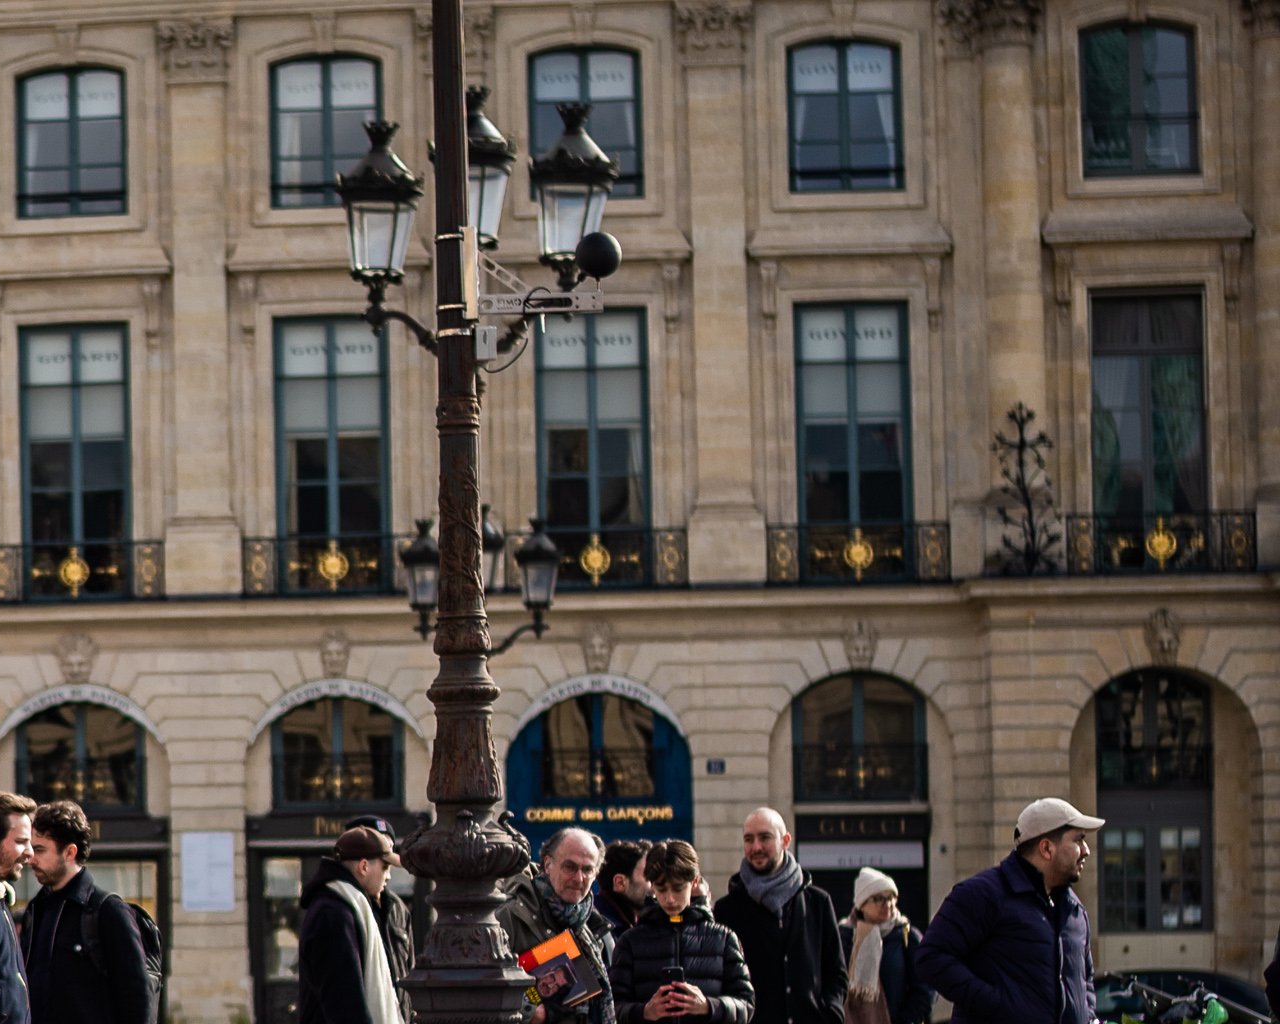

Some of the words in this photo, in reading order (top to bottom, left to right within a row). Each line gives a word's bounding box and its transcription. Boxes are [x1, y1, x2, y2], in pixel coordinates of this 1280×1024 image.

[525, 806, 576, 822] COMME
[580, 806, 604, 821] des
[606, 804, 674, 826] GARÇONS
[819, 818, 906, 835] GUCCI
